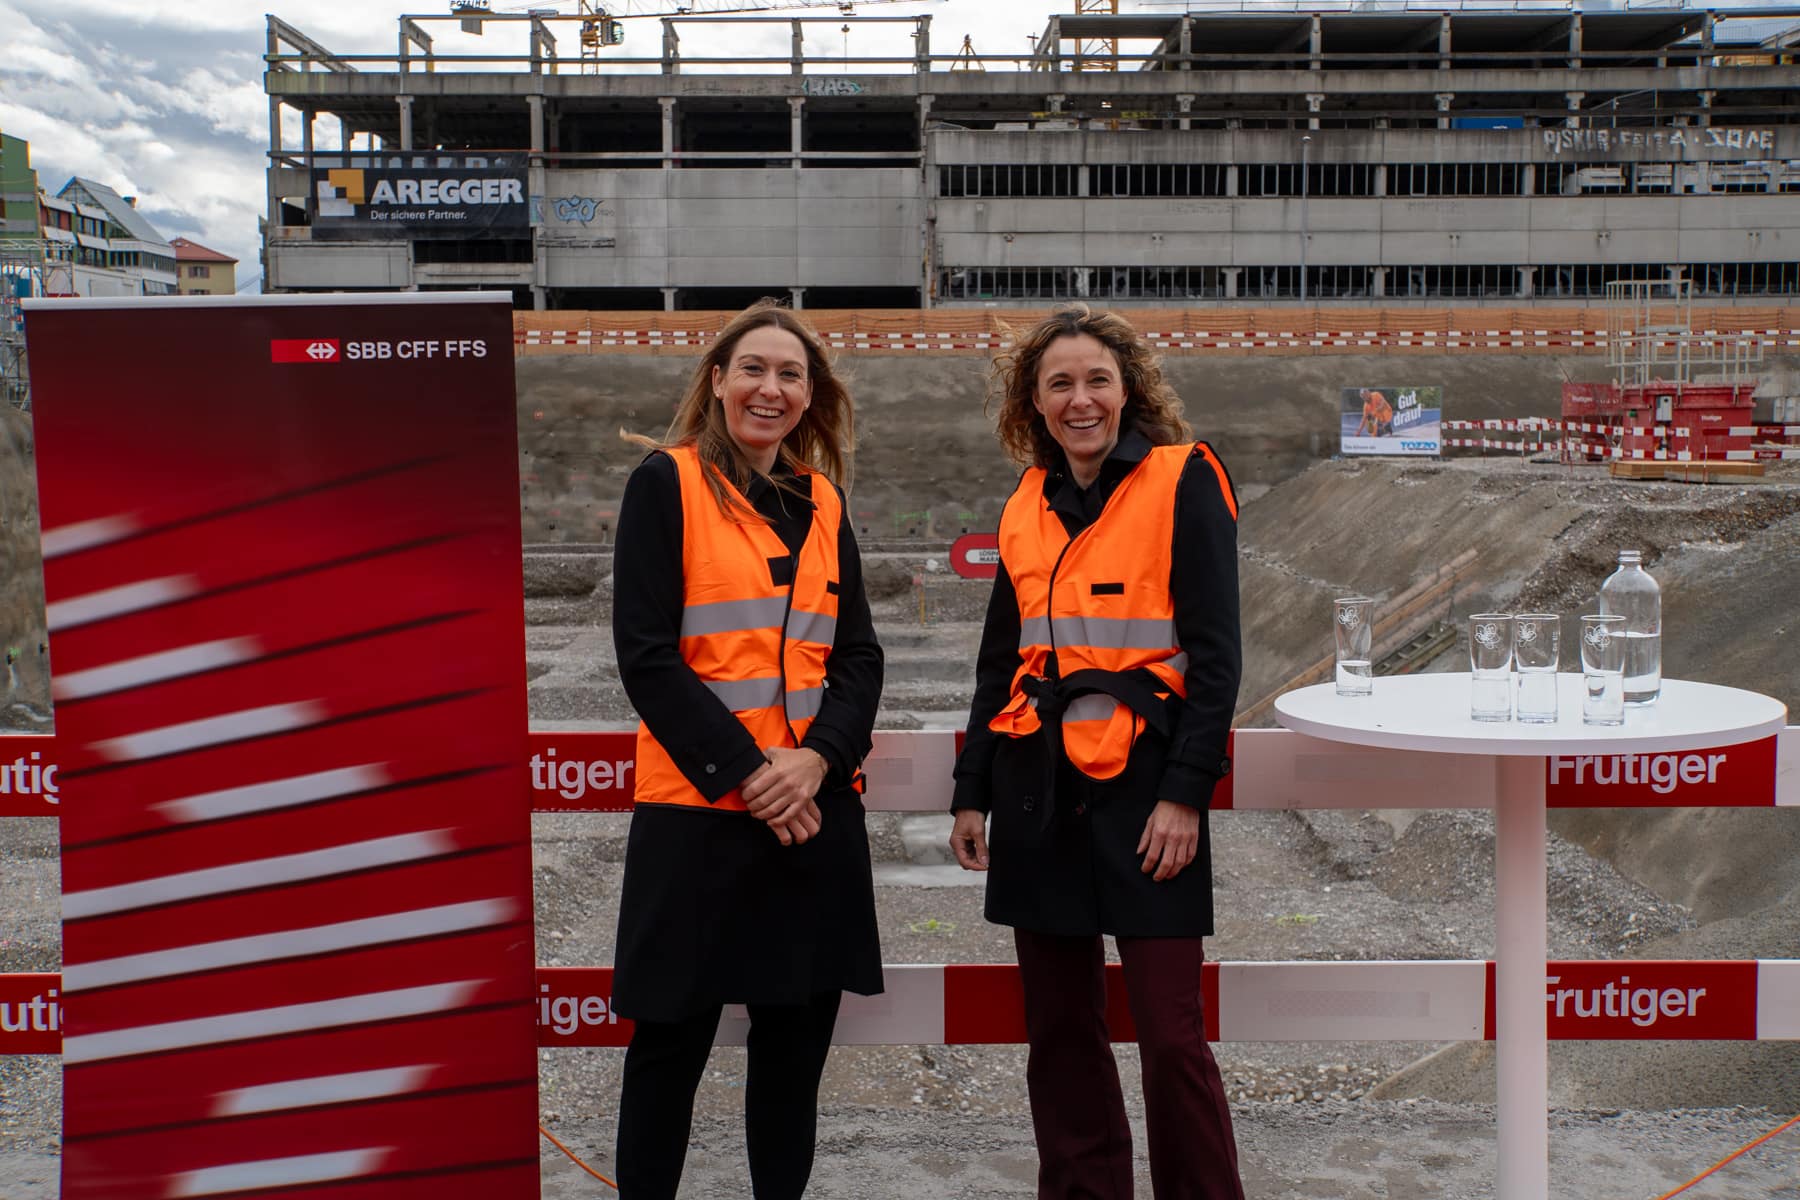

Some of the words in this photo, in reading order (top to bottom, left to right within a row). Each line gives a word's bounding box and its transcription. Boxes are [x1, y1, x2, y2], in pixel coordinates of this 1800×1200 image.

[370, 179, 524, 205] AREGGER
[370, 210, 388, 220] Der
[391, 210, 425, 220] sichere
[428, 210, 467, 220] Partner.
[346, 341, 392, 359] SBB
[397, 340, 439, 358] CFF
[445, 339, 487, 358] FFS
[1398, 390, 1417, 410] Gut
[1393, 404, 1422, 426] drauf
[529, 747, 634, 800] tiger
[1550, 753, 1727, 794] Frutiger
[0, 988, 64, 1036] uti
